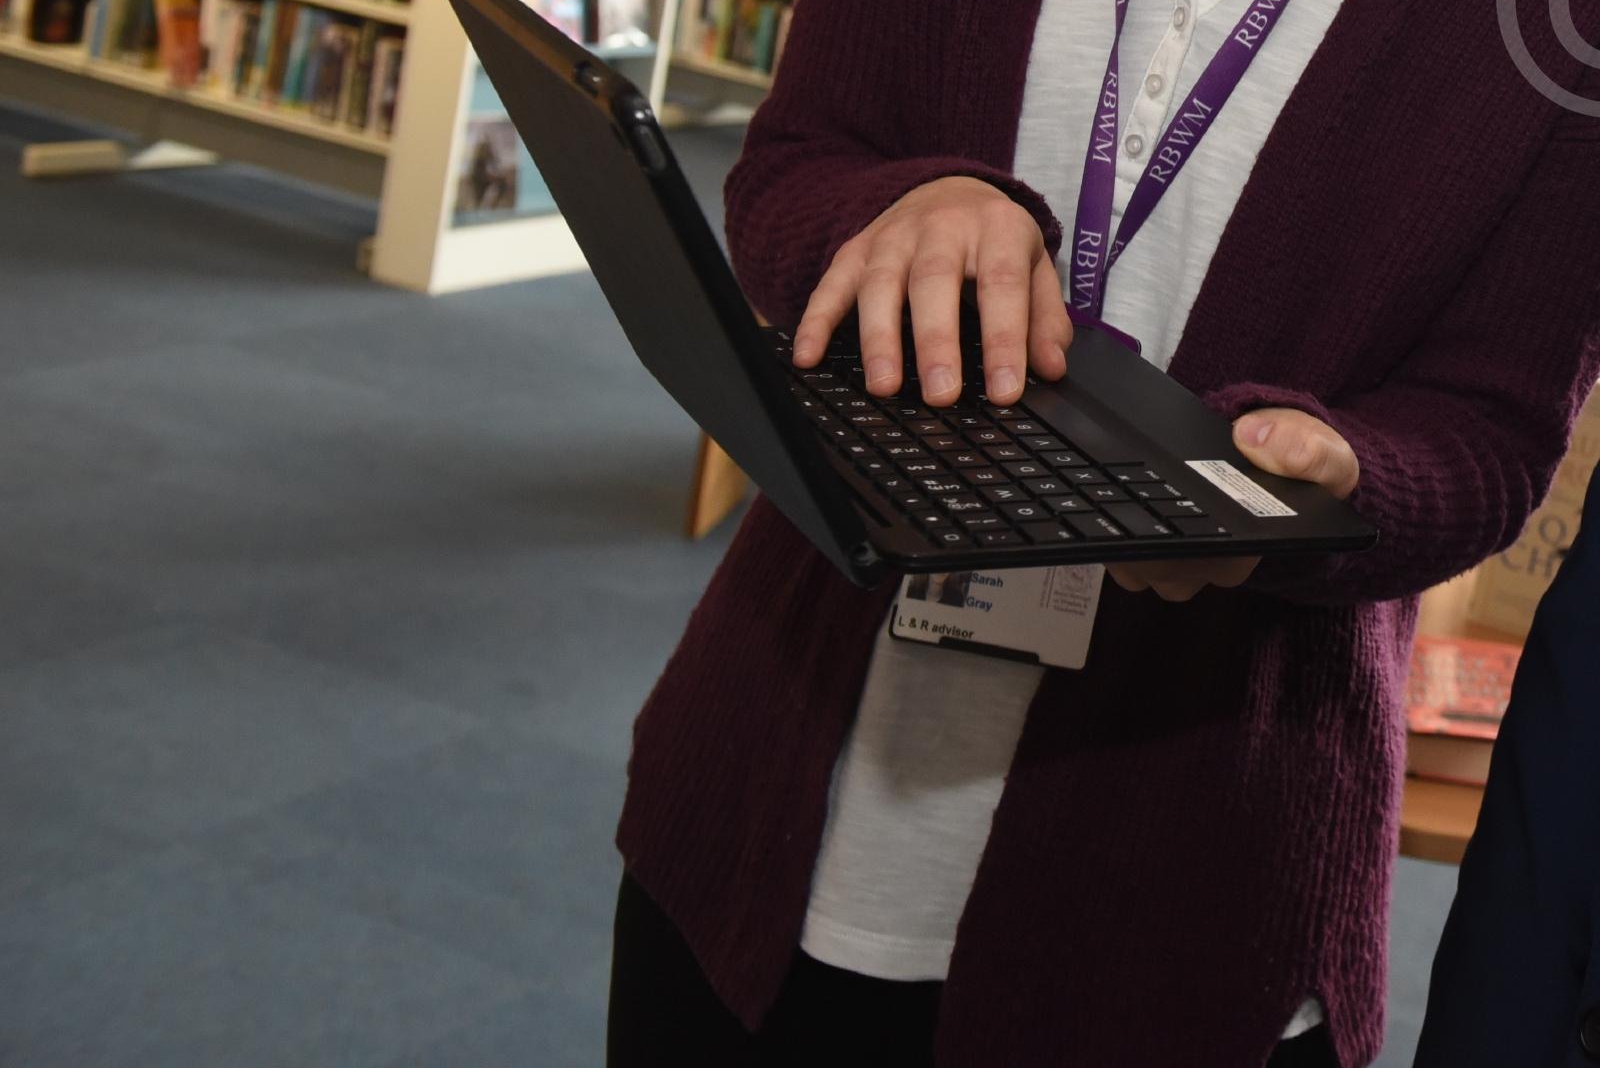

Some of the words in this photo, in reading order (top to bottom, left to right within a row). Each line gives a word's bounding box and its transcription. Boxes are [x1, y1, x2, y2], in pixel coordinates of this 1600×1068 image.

[1092, 70, 1118, 165] RBWM
[1148, 97, 1214, 184] RBWM
[970, 572, 1005, 588] Sarah
[966, 596, 993, 613] Gray
[920, 619, 929, 631] R
[931, 622, 975, 640] advisor
